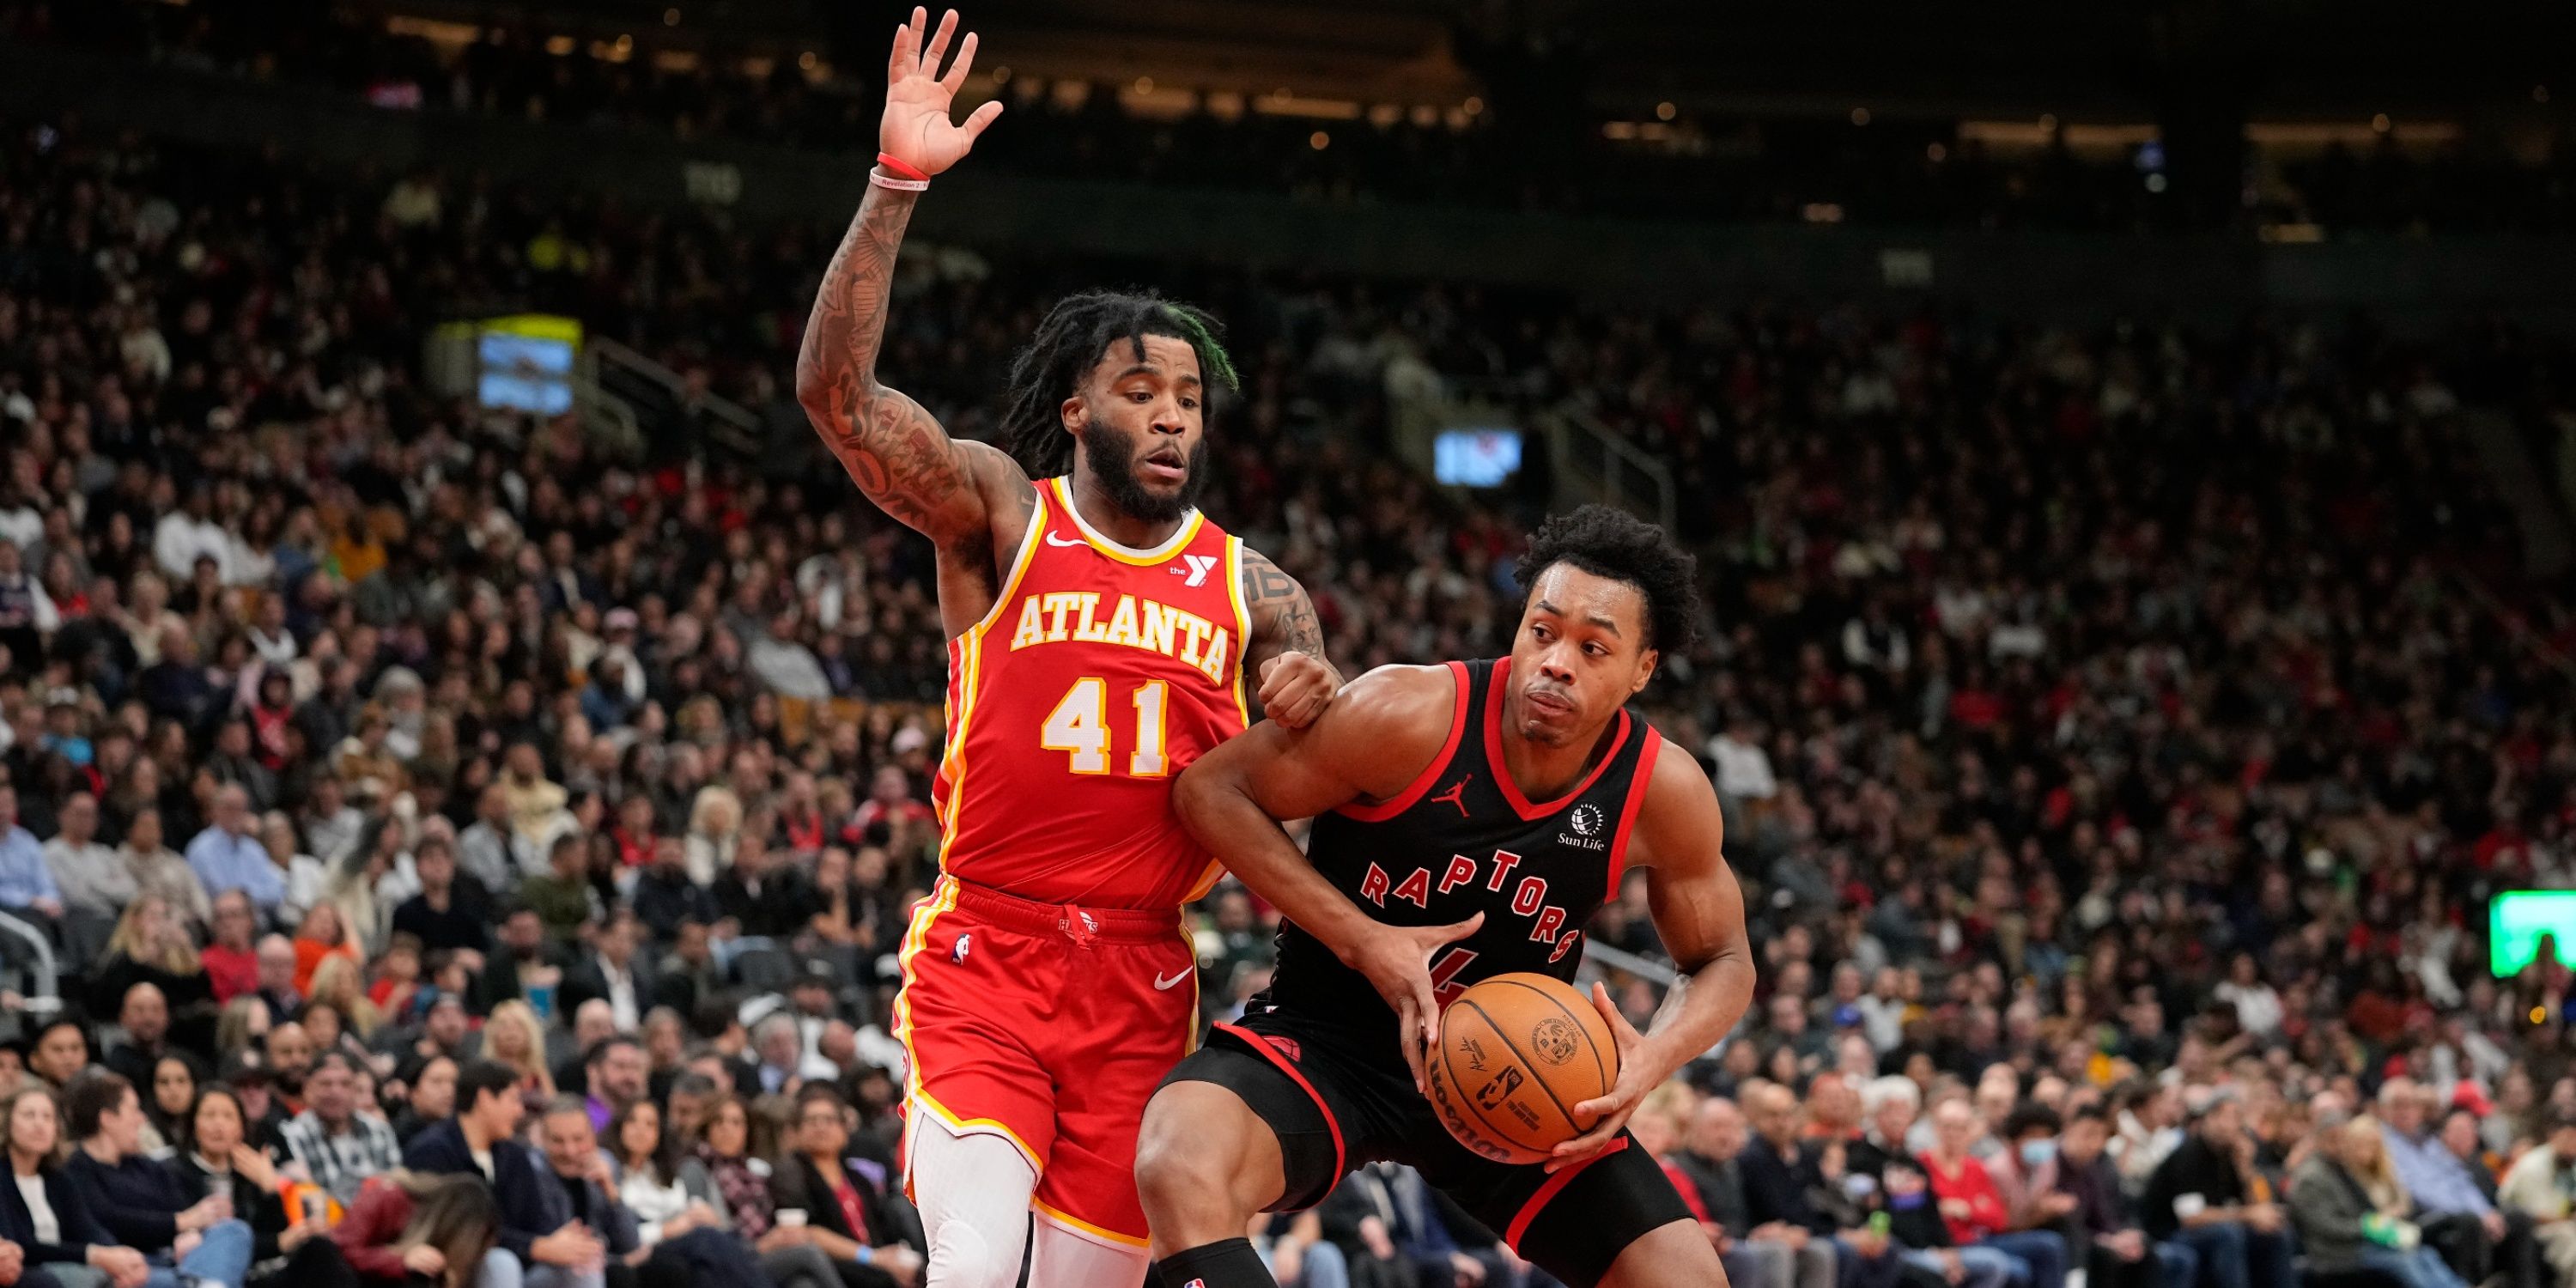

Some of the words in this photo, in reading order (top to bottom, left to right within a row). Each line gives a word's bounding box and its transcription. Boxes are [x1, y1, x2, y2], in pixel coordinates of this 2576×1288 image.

[882, 179, 914, 188] Revelation
[1170, 566, 1186, 575] the
[1010, 592, 1229, 687] ATLANTA
[1041, 677, 1169, 776] 41
[1558, 832, 1581, 847] Sun
[1583, 838, 1605, 851] Life
[1360, 849, 1579, 963] RAPTORS
